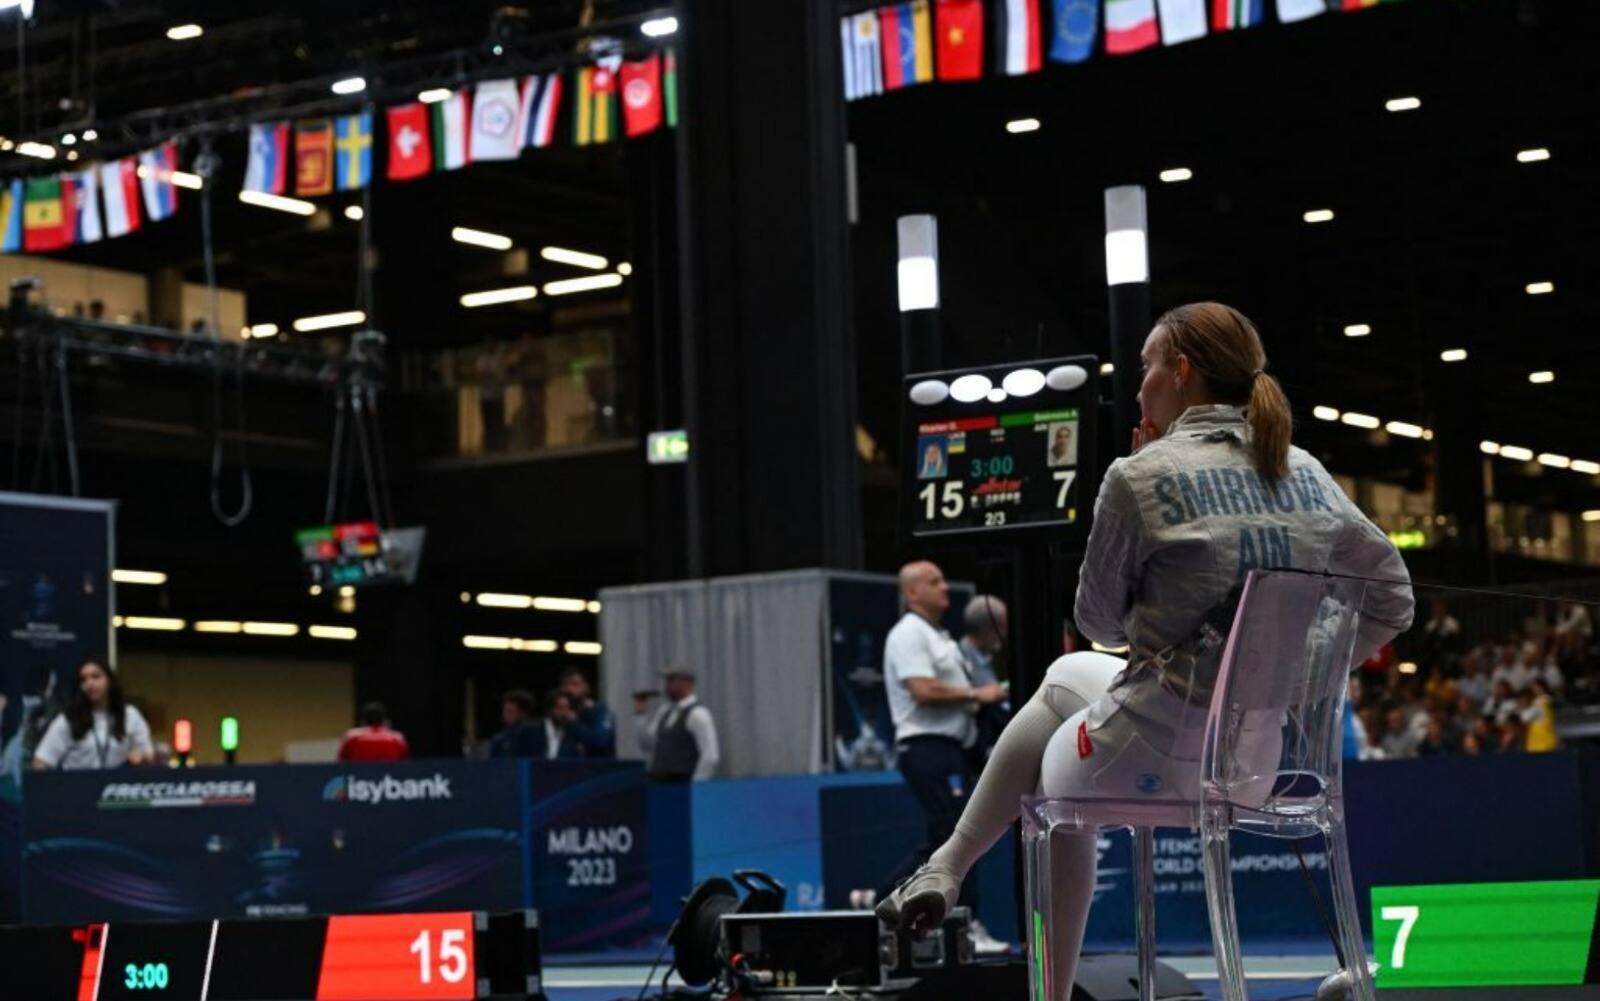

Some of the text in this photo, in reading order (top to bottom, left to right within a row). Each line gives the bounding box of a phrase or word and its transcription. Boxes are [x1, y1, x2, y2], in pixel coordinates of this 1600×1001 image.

[970, 456, 1014, 478] 3:00
[918, 480, 964, 520] 15
[1052, 470, 1076, 509] 7
[1154, 466, 1332, 526] SMIRNOVA
[984, 511, 1006, 527] 2/3
[1237, 526, 1293, 580] AIN
[101, 780, 256, 801] FRECCIAROSSA
[347, 773, 452, 805] isybank
[547, 825, 634, 855] MILANO
[566, 857, 617, 886] 2023
[1152, 856, 1200, 876] ORLD
[1380, 905, 1420, 969] 7
[409, 928, 468, 985] 15
[124, 962, 169, 989] 3:00
